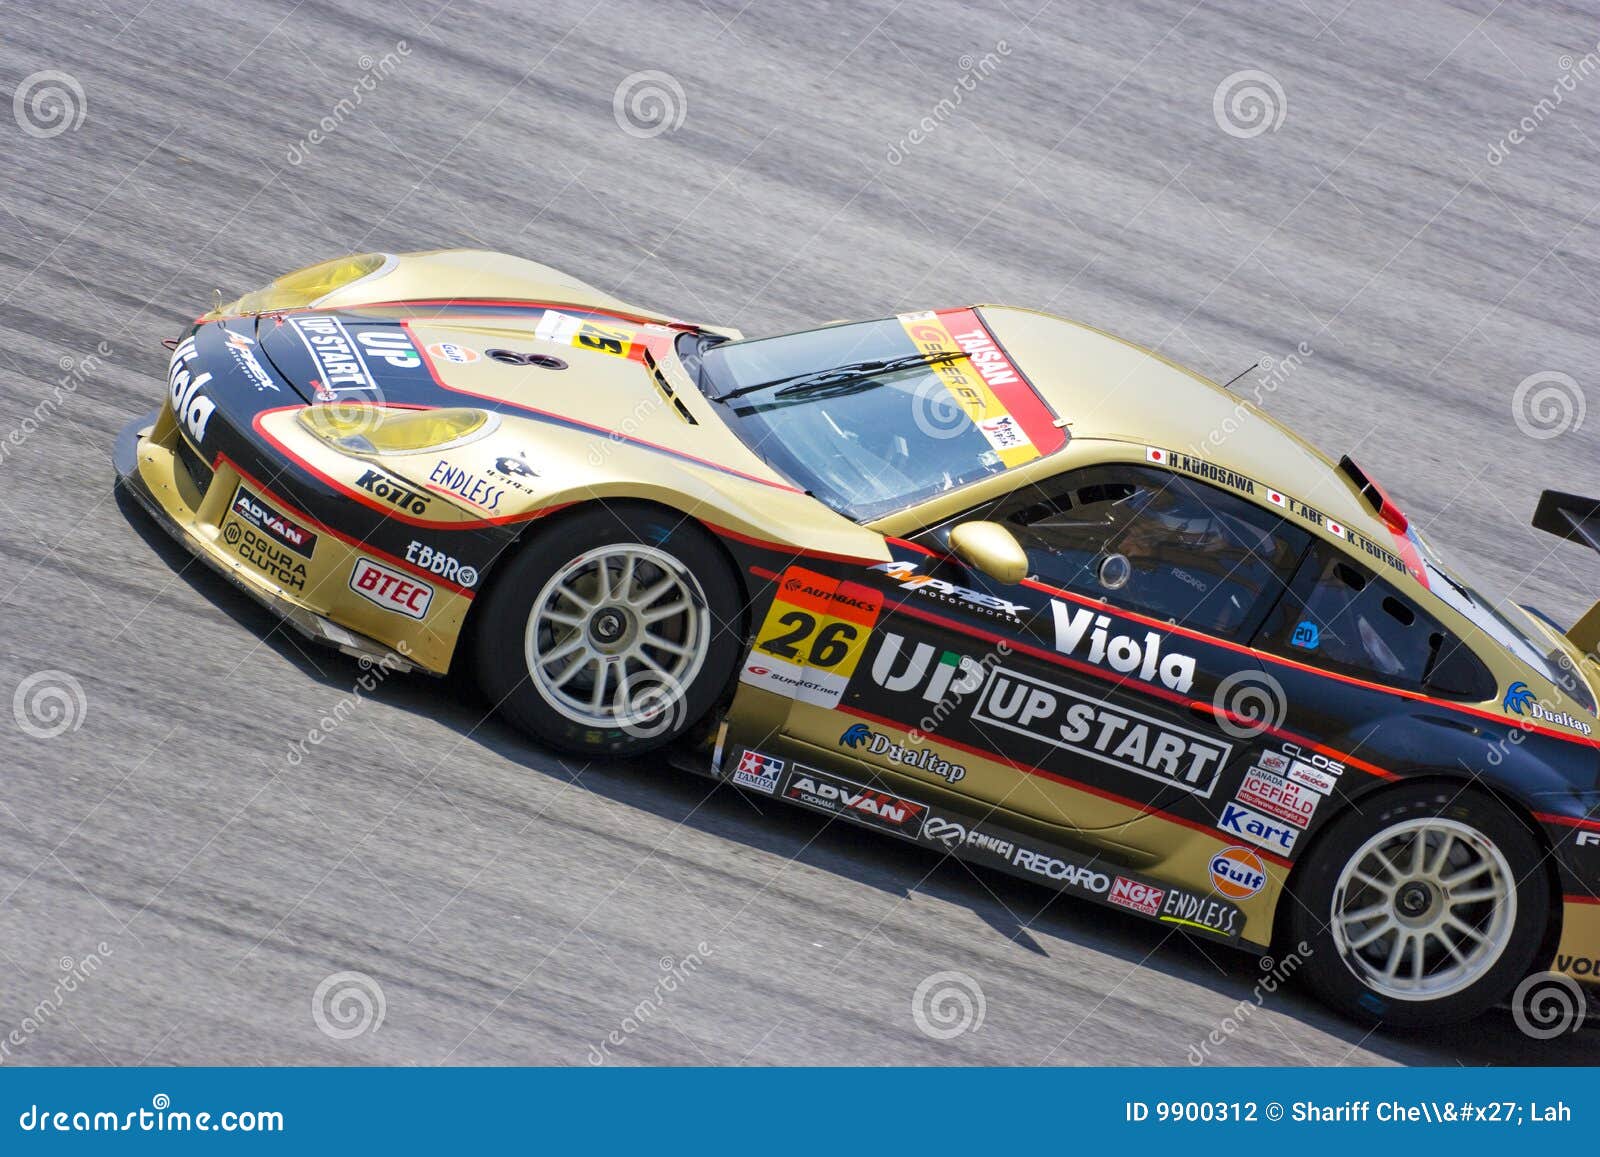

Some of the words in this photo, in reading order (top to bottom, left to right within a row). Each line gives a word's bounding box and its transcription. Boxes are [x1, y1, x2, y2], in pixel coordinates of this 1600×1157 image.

[299, 319, 338, 335] UP
[310, 335, 367, 385] START
[356, 331, 422, 369] UP
[954, 328, 1019, 386] TAISAN
[429, 460, 506, 511] ENDLESS
[1168, 452, 1255, 496] H.KUROSAWA
[236, 496, 303, 546] ADVAN
[1288, 498, 1324, 527] T.ABE
[238, 543, 306, 592] CLUTCH
[244, 530, 308, 578] OGURA
[404, 540, 479, 588] EBBRO
[1346, 528, 1408, 576] K.TSUTSUI
[356, 566, 429, 614] BTEC
[918, 589, 1022, 625] motorsports
[758, 611, 858, 669] 26
[1050, 598, 1197, 694] Viola
[1295, 626, 1312, 642] 20
[871, 632, 985, 703] UP
[987, 678, 1058, 726] UP
[1059, 702, 1220, 784] START
[1530, 702, 1592, 736] Dualtap
[735, 770, 775, 791] TAMIYA
[868, 732, 967, 784] Dualtap
[1249, 768, 1285, 787] CANADA
[1282, 742, 1346, 777] CLOS
[791, 777, 906, 822] ADVAN
[1244, 776, 1314, 815] ICEFIELD
[1220, 804, 1295, 849] Kart
[1012, 848, 1111, 894] RECARO
[1112, 876, 1165, 909] NGK
[1212, 858, 1264, 890] Gulf
[1164, 890, 1238, 932] ENDLESS
